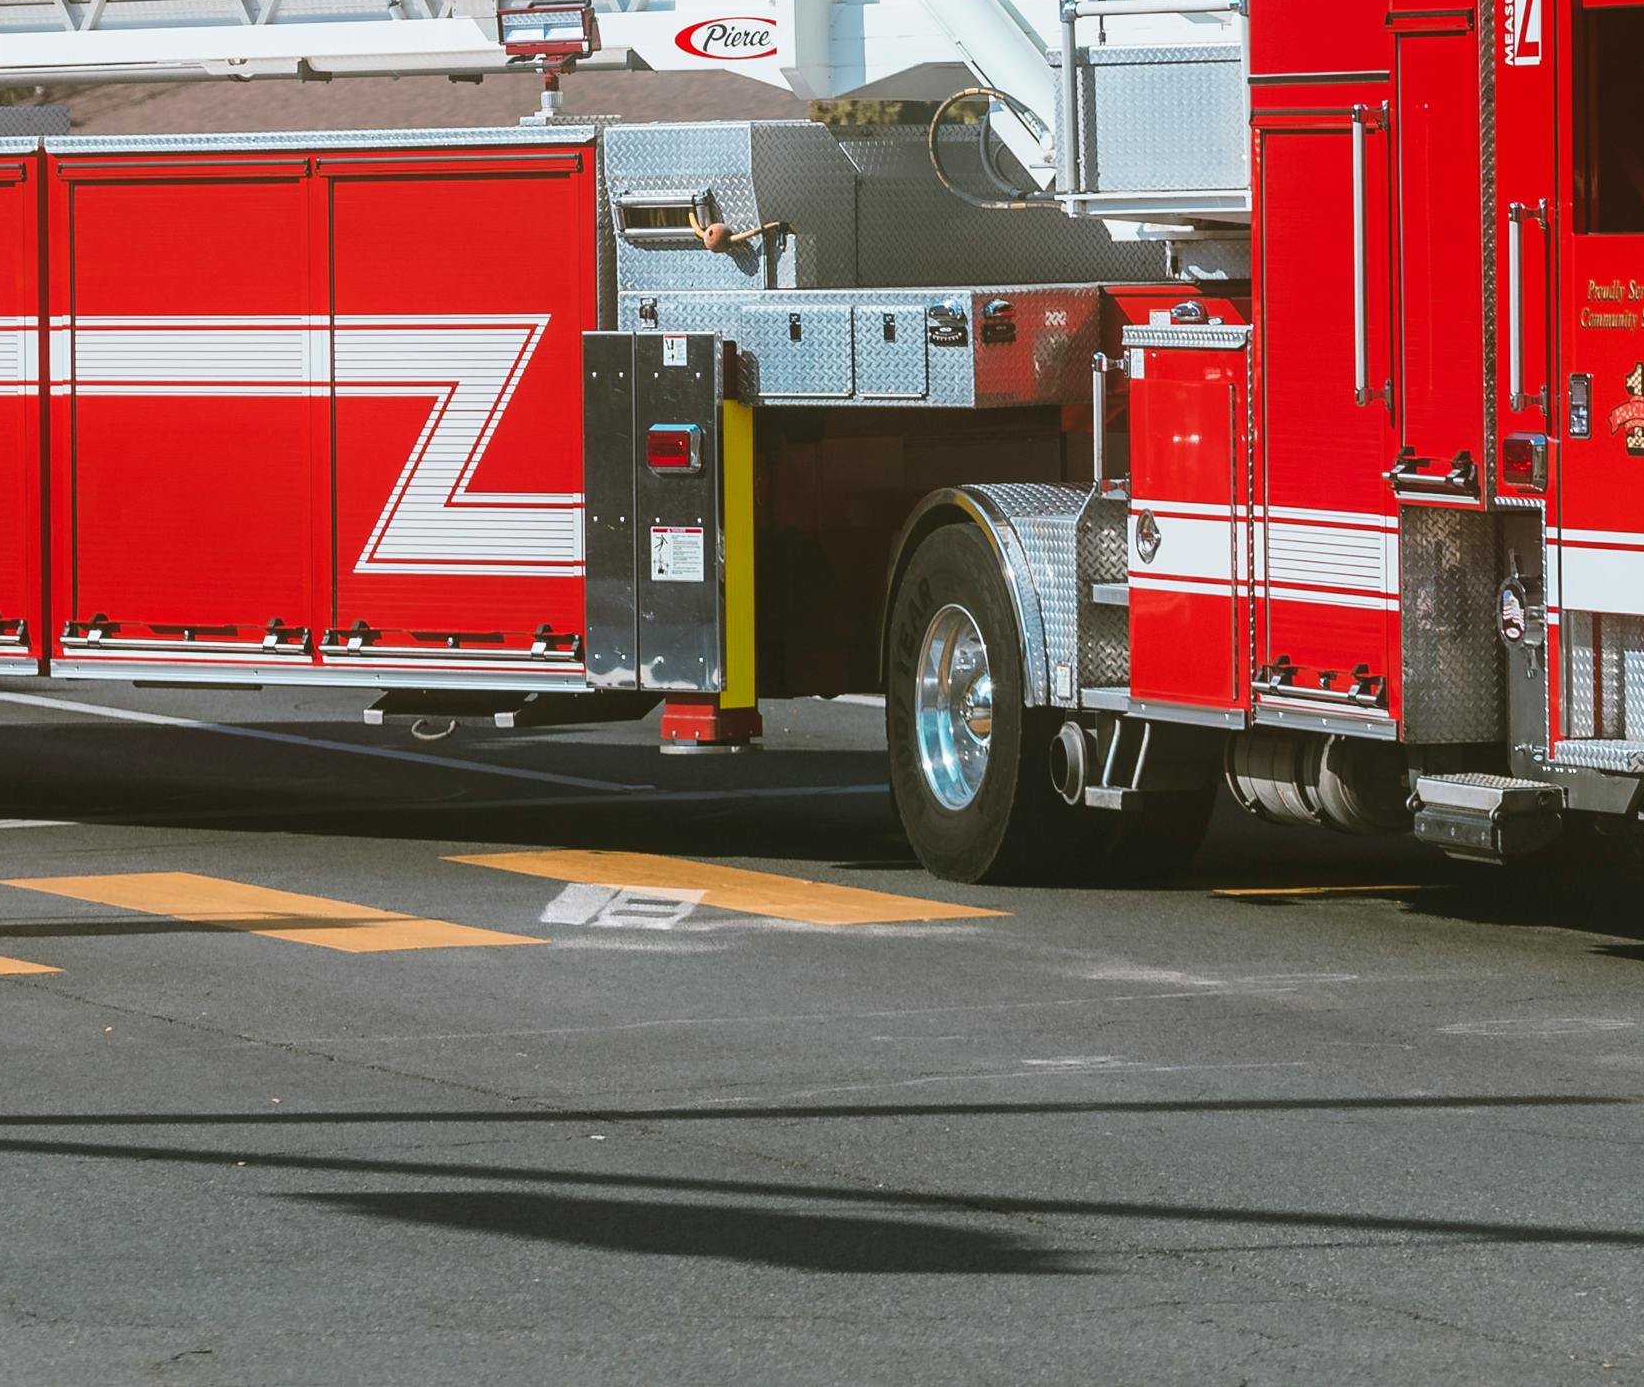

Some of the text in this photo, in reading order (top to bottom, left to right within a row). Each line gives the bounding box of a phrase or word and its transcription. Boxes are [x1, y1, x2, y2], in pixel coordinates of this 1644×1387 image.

[703, 24, 772, 52] Pierce
[1587, 279, 1625, 302] Proudly
[1580, 307, 1637, 332] Community
